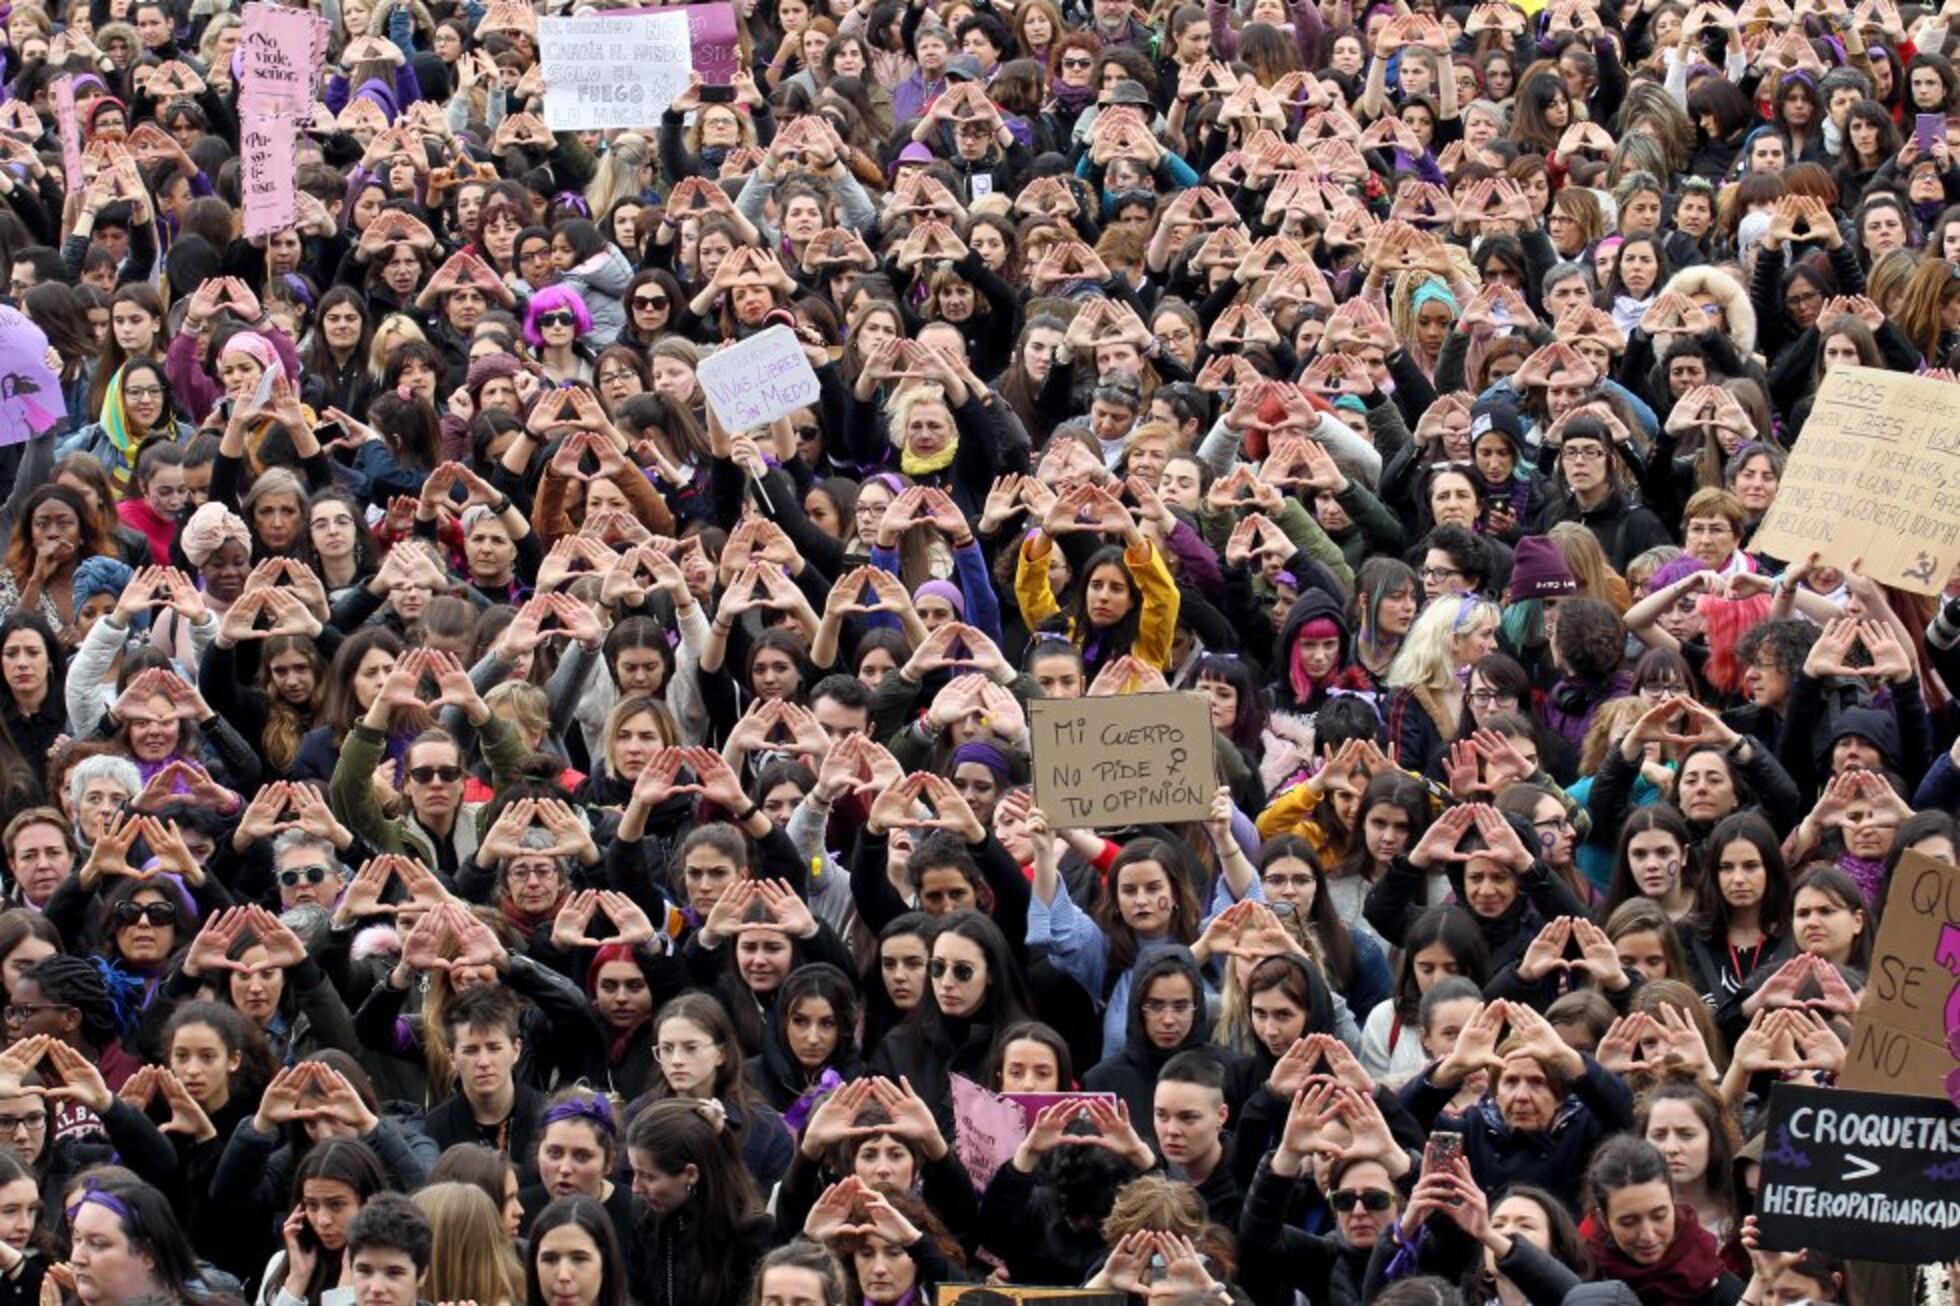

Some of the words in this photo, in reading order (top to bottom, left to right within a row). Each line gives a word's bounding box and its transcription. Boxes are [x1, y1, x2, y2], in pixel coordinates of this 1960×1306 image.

[548, 66, 601, 83] SOLO
[577, 84, 645, 104] FUEGO
[1101, 722, 1184, 746] CUERPO
[1062, 797, 1093, 818] TU
[1877, 954, 1926, 1010] SE
[1857, 1023, 1911, 1079] NO
